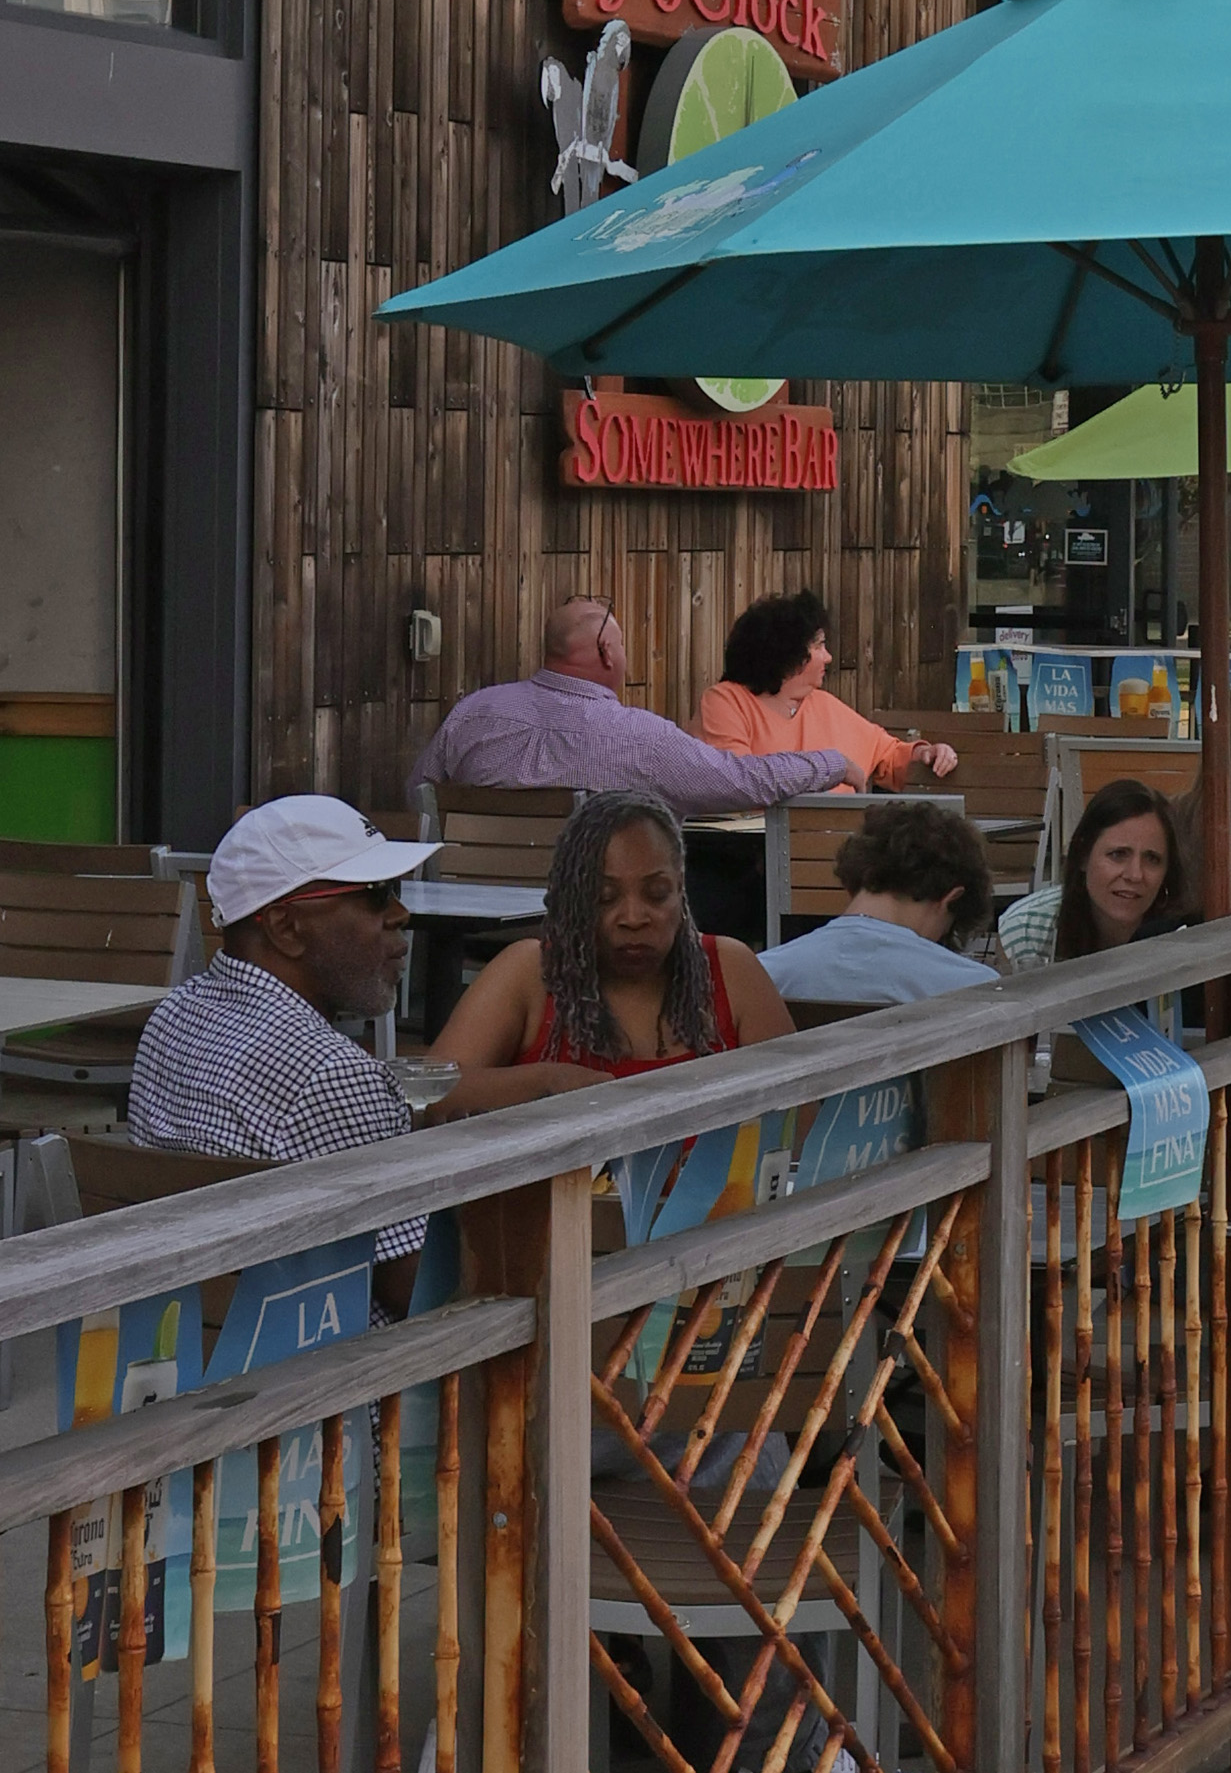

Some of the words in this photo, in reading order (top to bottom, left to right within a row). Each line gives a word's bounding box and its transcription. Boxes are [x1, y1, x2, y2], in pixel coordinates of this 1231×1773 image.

[1044, 683, 1078, 697] VIDA
[1052, 668, 1071, 681] LA
[1101, 1016, 1140, 1044] LA
[1125, 1047, 1181, 1079] VIDA
[858, 1080, 914, 1128] VIDA
[1150, 1130, 1195, 1174] FINA
[297, 1292, 341, 1349] LA
